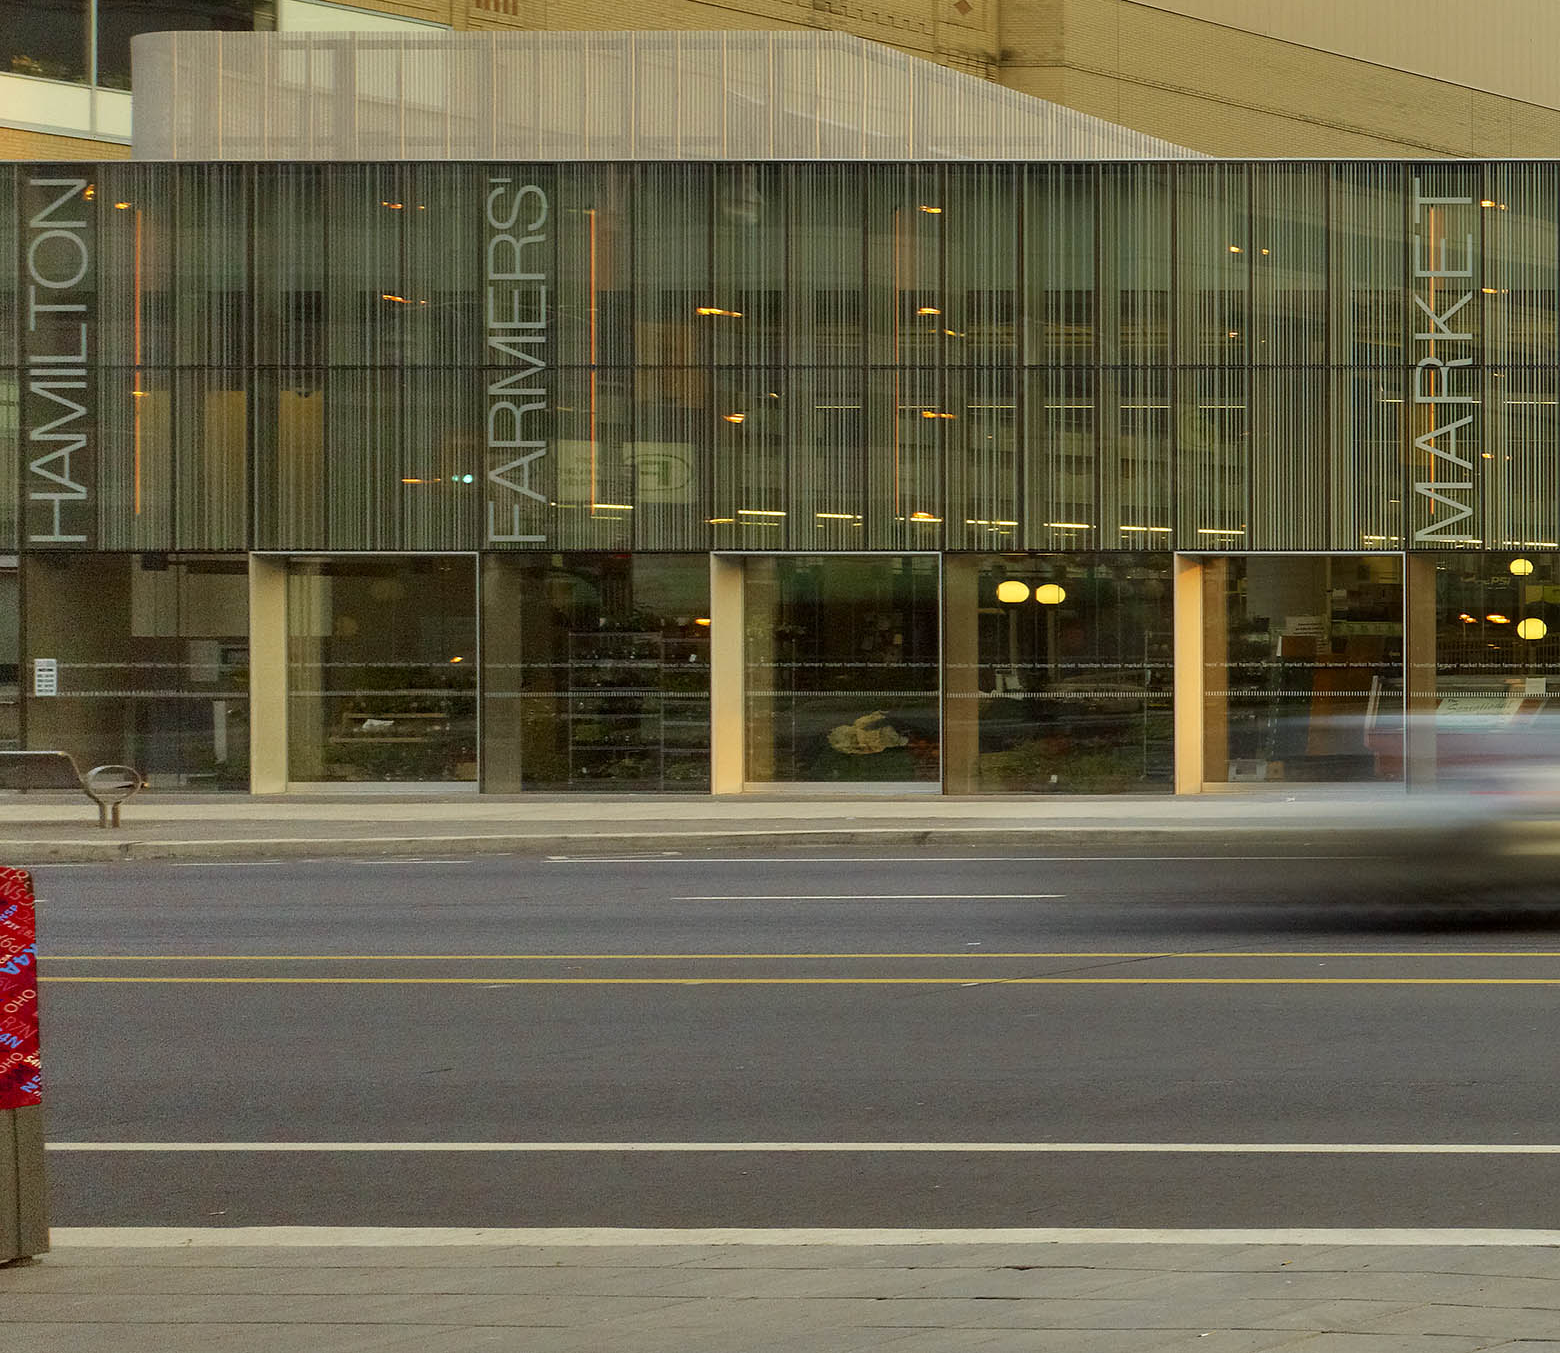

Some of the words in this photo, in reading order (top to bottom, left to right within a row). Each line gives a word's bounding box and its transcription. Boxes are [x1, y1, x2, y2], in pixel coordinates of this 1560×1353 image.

[28, 178, 88, 543] HAMILTON
[487, 177, 548, 542] FARMERS'
[1414, 177, 1473, 541] MARKET
